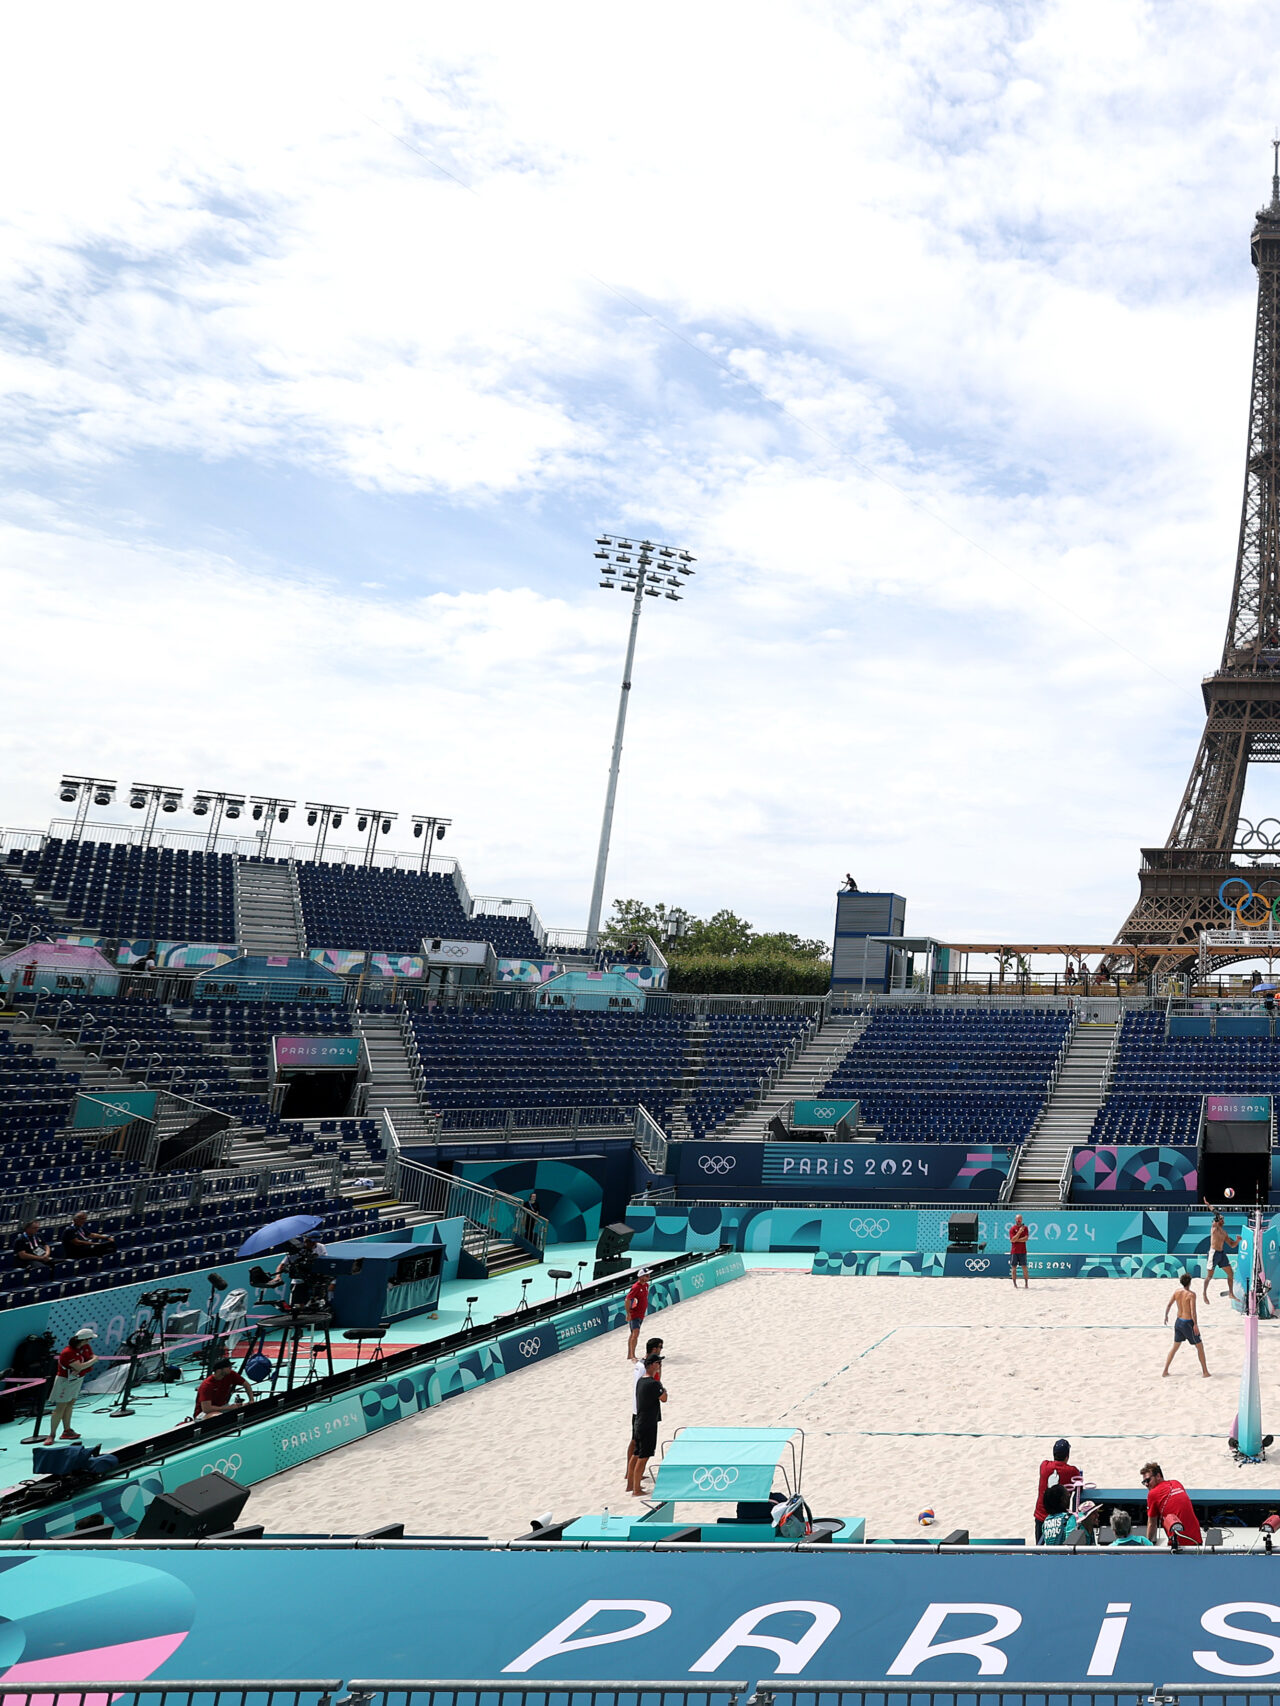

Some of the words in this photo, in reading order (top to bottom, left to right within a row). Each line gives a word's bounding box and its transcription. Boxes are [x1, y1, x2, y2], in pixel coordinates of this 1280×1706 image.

[321, 1047, 353, 1055] 2024
[865, 1158, 929, 1176] 2024
[1028, 1222, 1096, 1241] 2024
[1046, 1261, 1072, 1269] 2024
[582, 1317, 602, 1331] 2024
[324, 1413, 358, 1434] 2024
